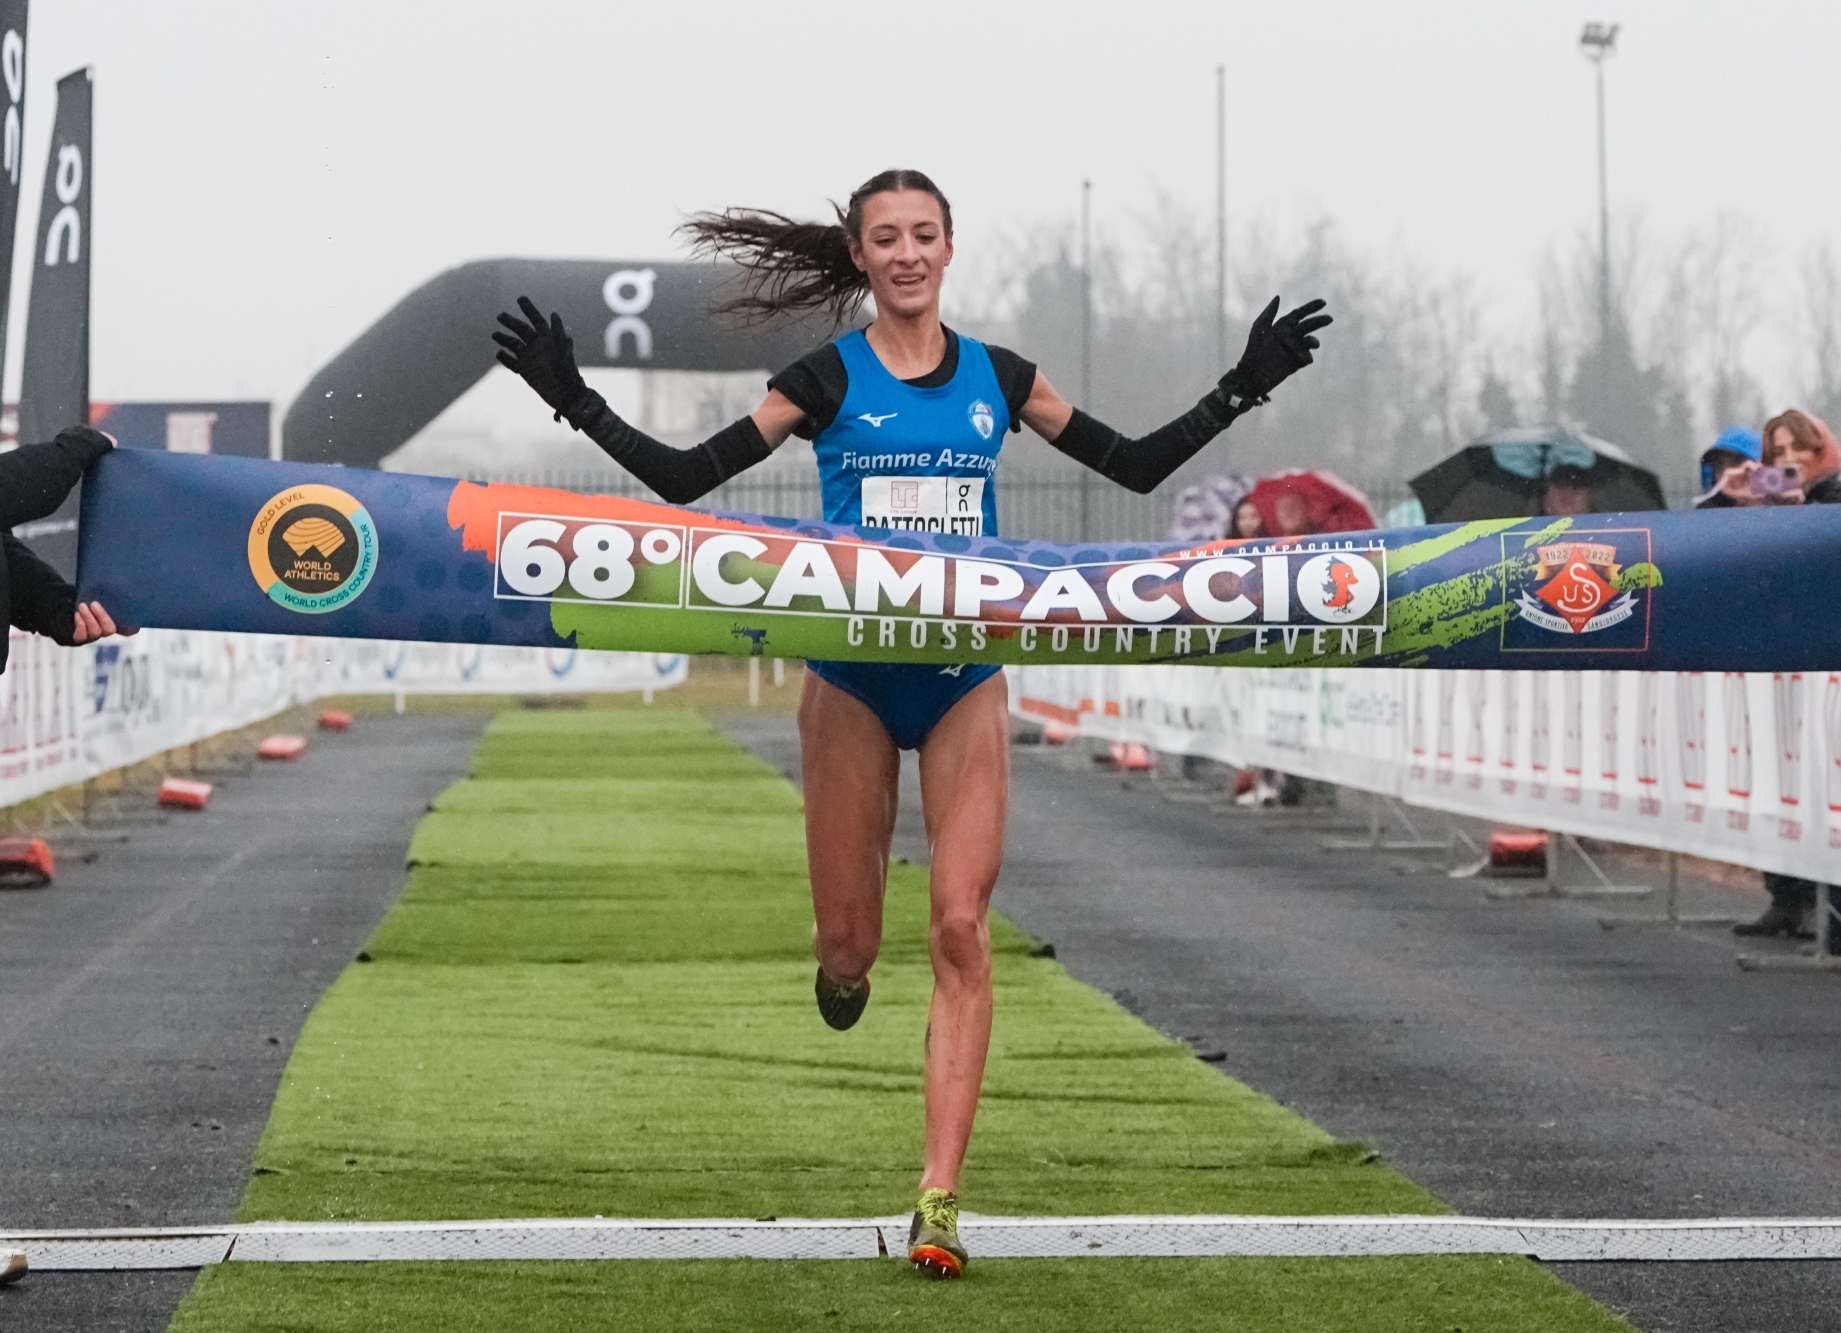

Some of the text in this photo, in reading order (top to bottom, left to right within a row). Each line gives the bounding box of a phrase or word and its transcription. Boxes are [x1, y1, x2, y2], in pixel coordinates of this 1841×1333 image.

[842, 451, 931, 470] Fiamme
[257, 491, 305, 536] GOLD LEVEL
[284, 523, 372, 608] WORLD CROSS COUNTRY TOUR
[293, 560, 332, 571] WORLD
[1546, 550, 1611, 562] 1922 2022
[284, 570, 340, 582] ATHLETICS
[692, 534, 1380, 624] CAMPACCIO
[848, 617, 1386, 655] CROSS COUNTRY EVENT
